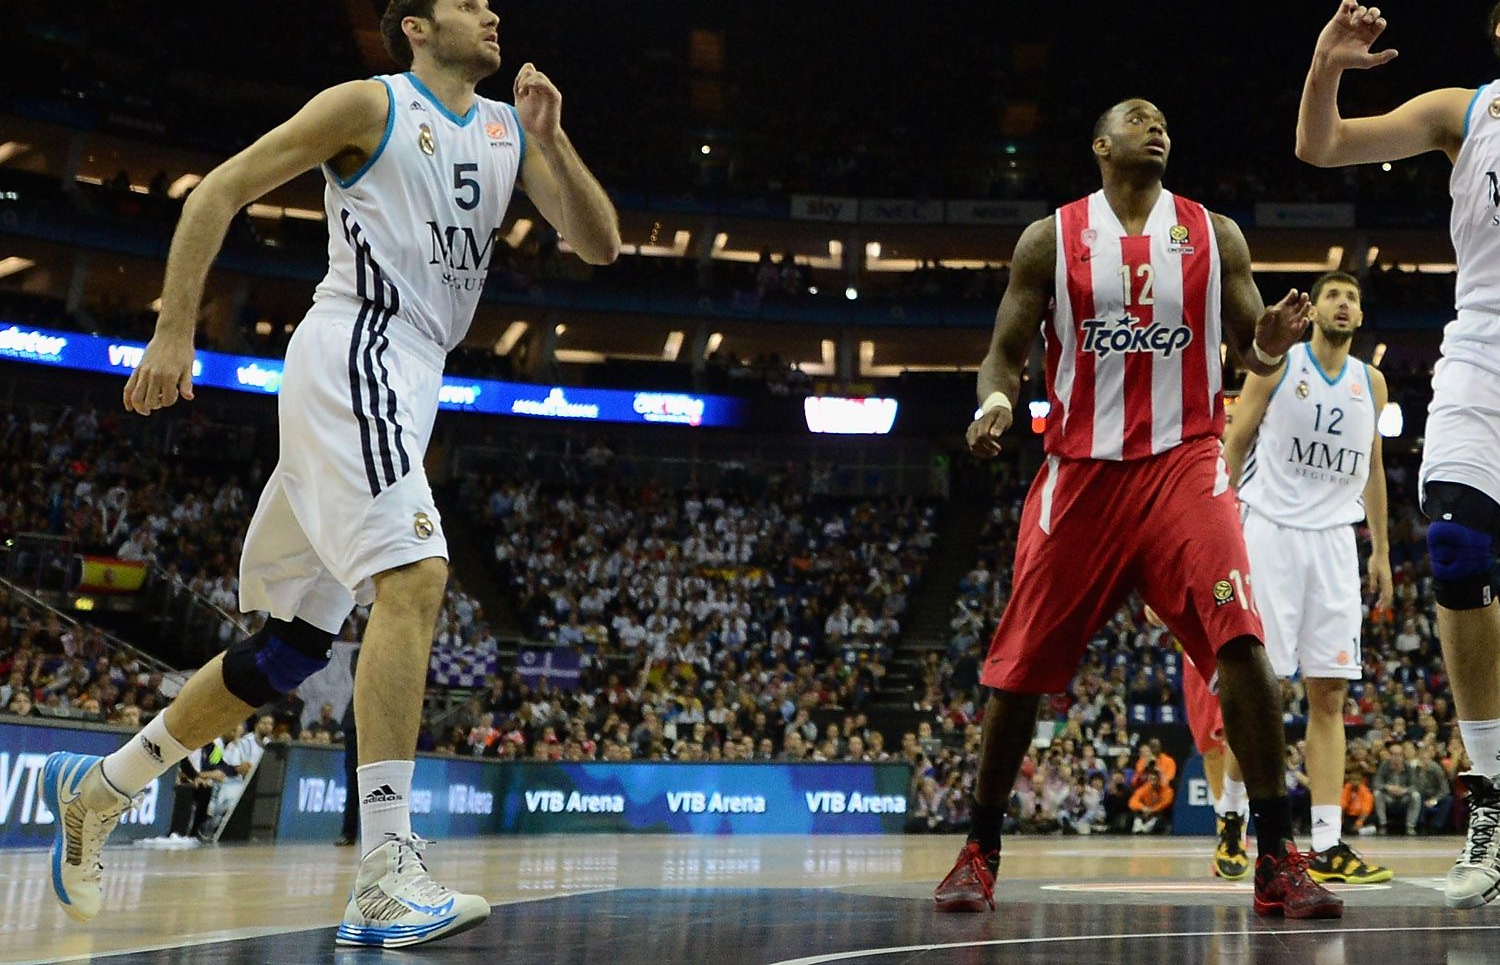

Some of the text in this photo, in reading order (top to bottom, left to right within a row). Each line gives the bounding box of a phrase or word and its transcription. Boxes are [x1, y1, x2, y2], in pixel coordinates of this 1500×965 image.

[453, 163, 481, 211] 5
[426, 221, 501, 271] MM
[1118, 263, 1155, 306] 12
[1313, 403, 1345, 435] 12
[1288, 436, 1364, 476] MMT
[1229, 568, 1251, 610] 1
[363, 793, 403, 805] adidas
[525, 791, 625, 814] VTB Arena
[666, 791, 766, 814] VTB Arena
[806, 791, 906, 814] VTB Arena
